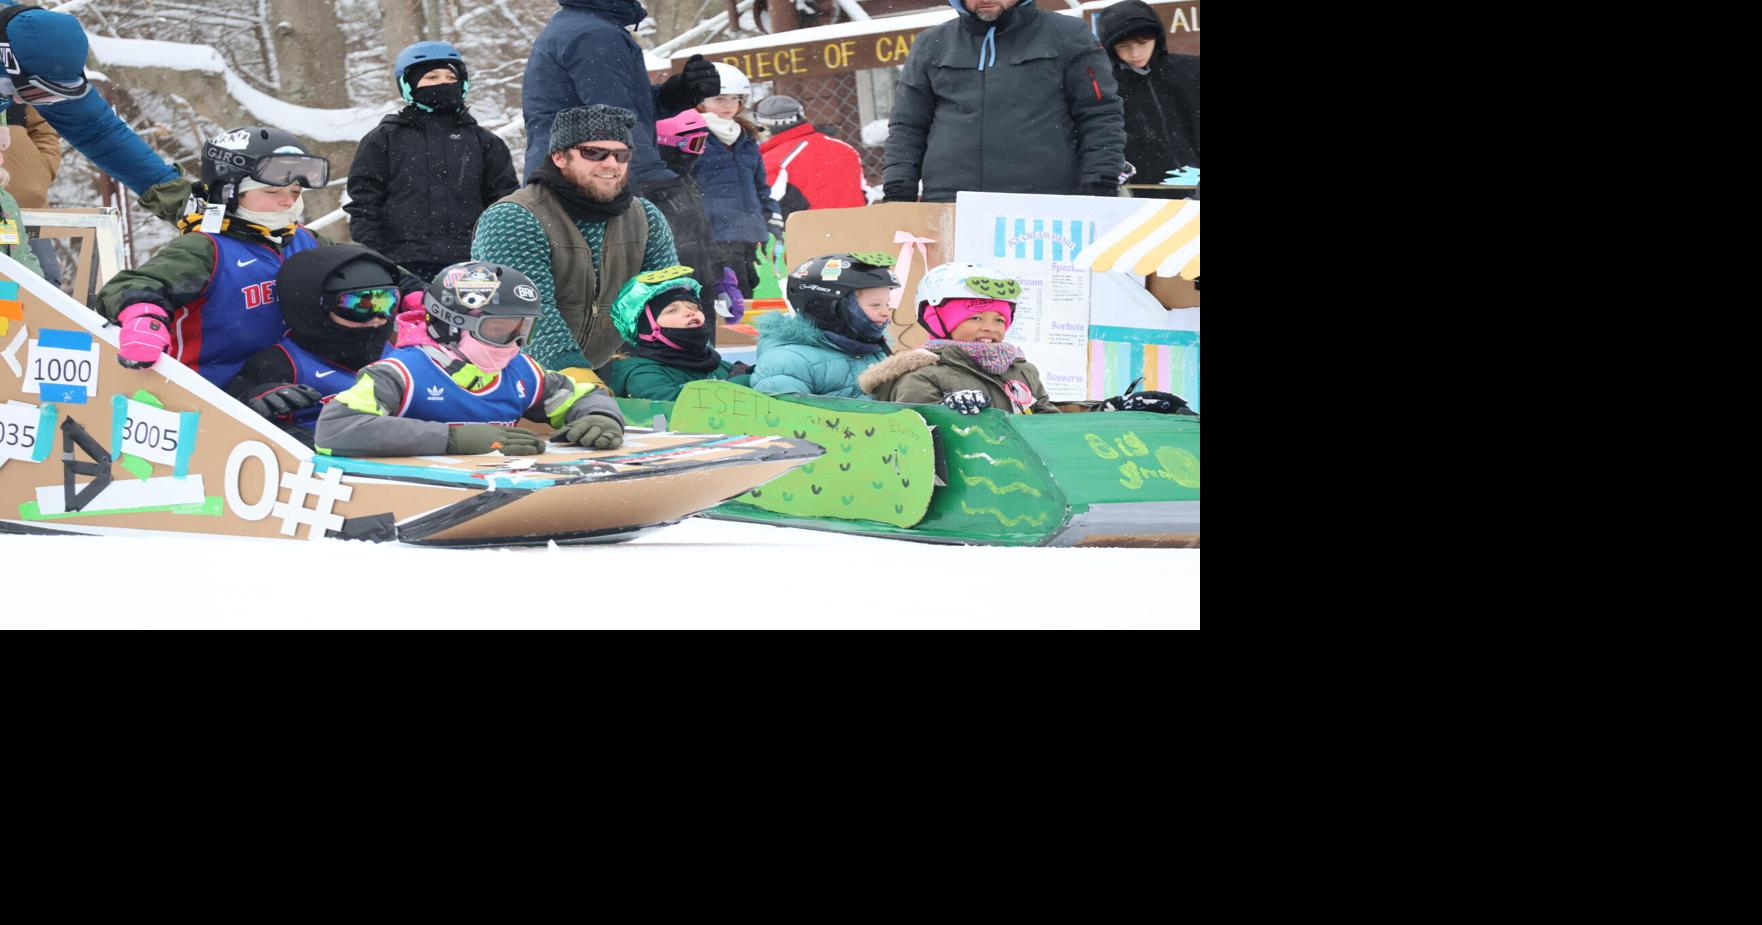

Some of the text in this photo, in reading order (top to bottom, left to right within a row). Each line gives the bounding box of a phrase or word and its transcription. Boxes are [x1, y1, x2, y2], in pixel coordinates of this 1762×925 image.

[824, 41, 856, 69] OF
[876, 34, 917, 63] CA
[207, 147, 246, 167] GIRO
[1022, 232, 1050, 241] CREAM
[1016, 276, 1043, 286] ream
[241, 280, 277, 309] DE
[431, 304, 465, 325] GIRO
[34, 358, 92, 382] 1000
[122, 417, 178, 451] 3005
